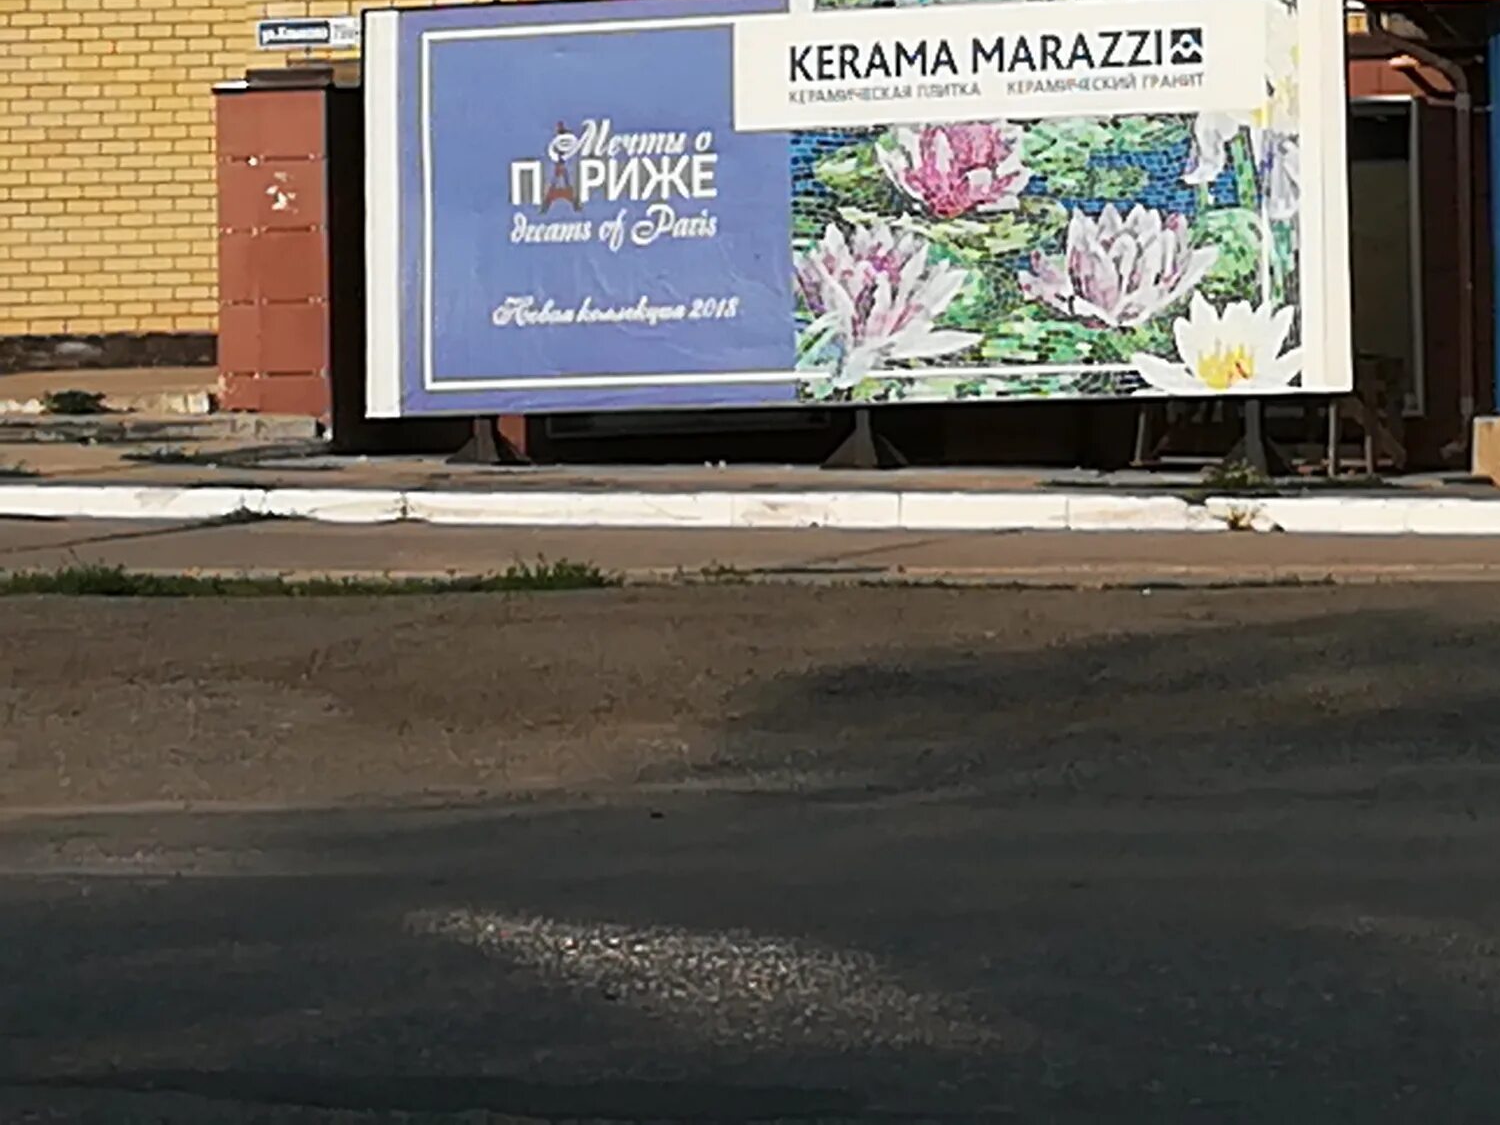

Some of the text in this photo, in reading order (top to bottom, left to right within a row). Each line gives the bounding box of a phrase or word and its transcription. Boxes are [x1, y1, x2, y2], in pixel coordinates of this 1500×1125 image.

[788, 30, 1163, 82] KERAMA MARAZZI
[788, 82, 982, 105] КЕРАМИЧЕСКАЯ ПЛИТКА
[1007, 72, 1204, 95] КЕРАМИЧЕСКИЙ ГРАНИТ
[598, 208, 627, 252] of
[631, 204, 718, 245] Paris
[688, 296, 739, 319] 2018
